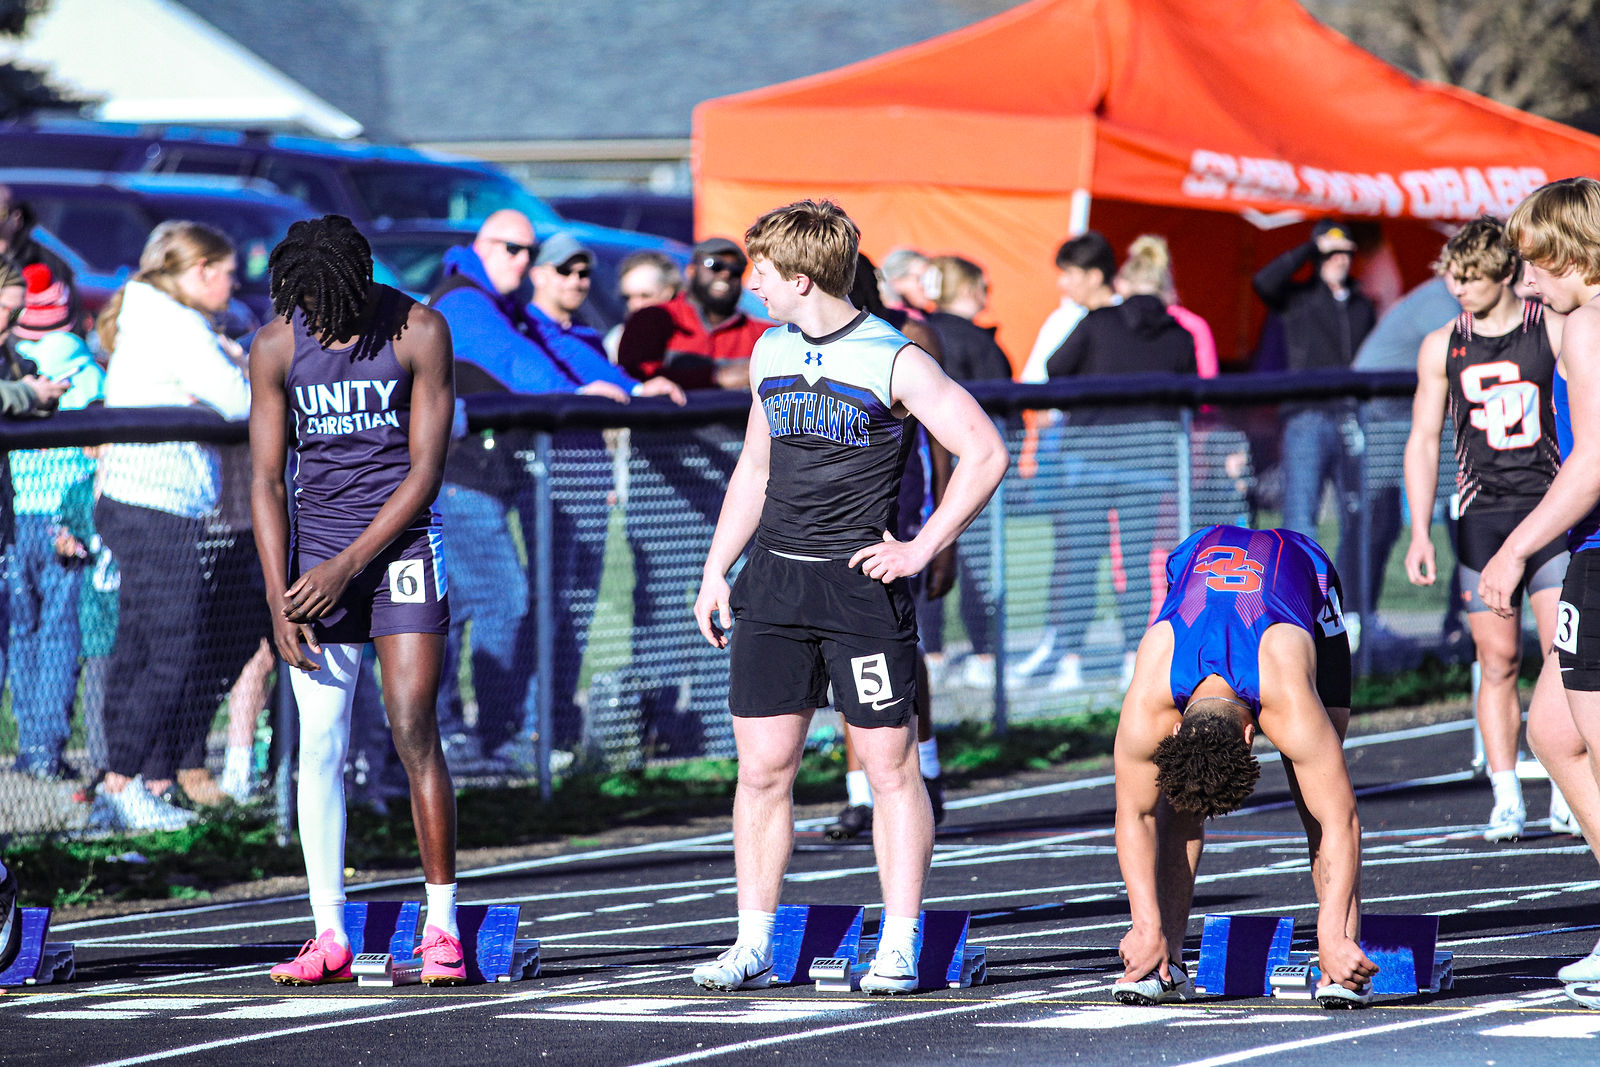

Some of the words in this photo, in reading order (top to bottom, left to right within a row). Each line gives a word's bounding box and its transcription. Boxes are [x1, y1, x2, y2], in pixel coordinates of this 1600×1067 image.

[295, 380, 398, 416] UNITY
[306, 410, 400, 435] CHRISTIAN
[396, 562, 418, 597] 6
[1322, 598, 1340, 628] 4
[1558, 607, 1573, 643] 3
[860, 659, 883, 696] 5
